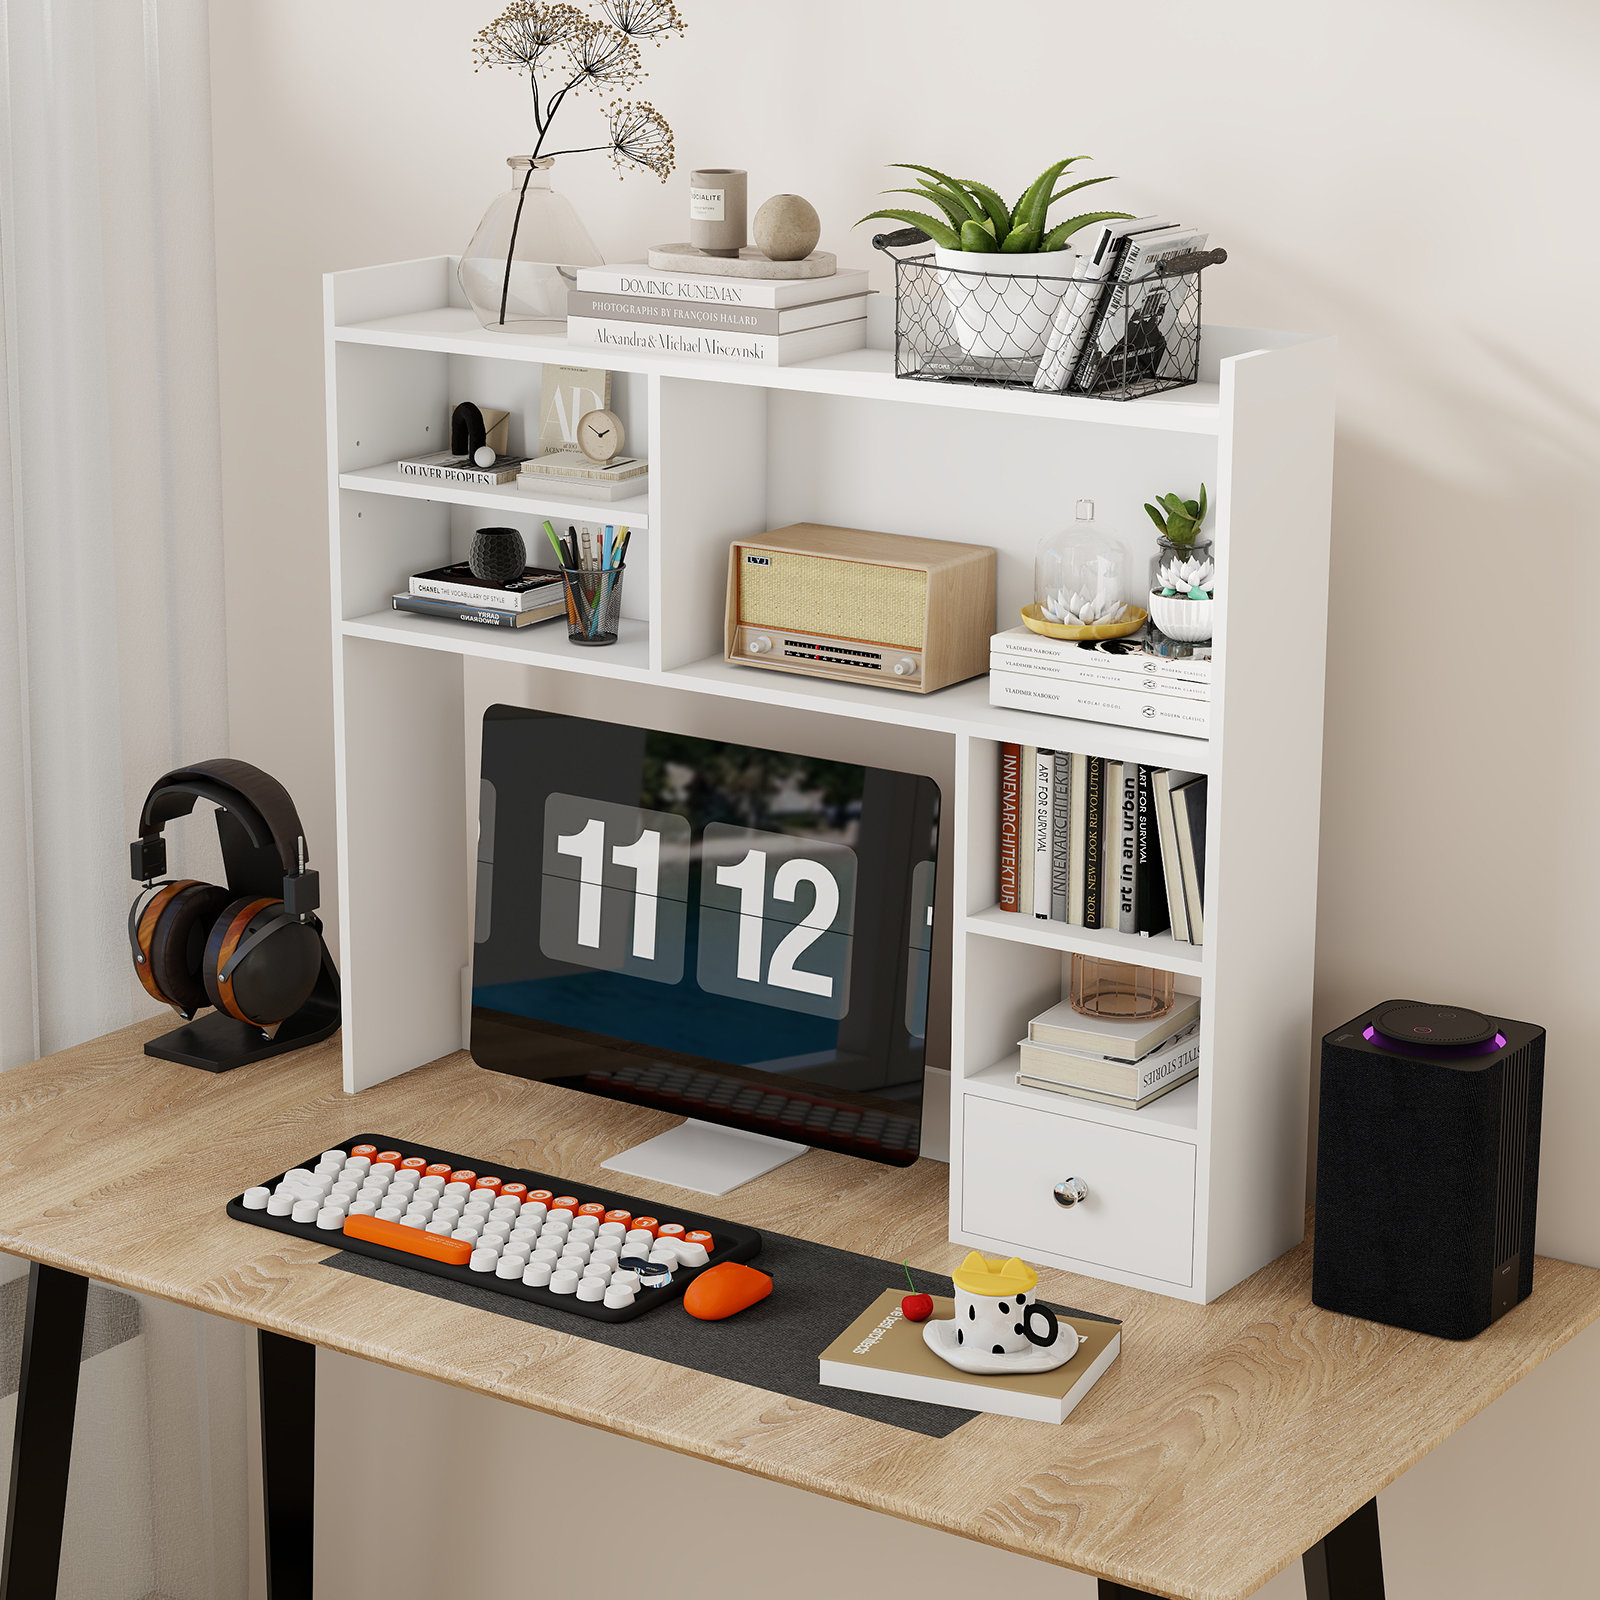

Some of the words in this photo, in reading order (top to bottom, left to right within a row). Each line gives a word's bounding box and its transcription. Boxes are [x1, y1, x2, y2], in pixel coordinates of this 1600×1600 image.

[1125, 244, 1141, 265] FINAL
[620, 278, 674, 297] DOMINIC
[678, 283, 742, 302] KUNEMAN
[592, 301, 659, 317] PHOTOGRAPHS
[661, 308, 672, 318] BY
[673, 309, 718, 323] FRANÇOIS
[720, 313, 758, 326] HALARD
[594, 328, 648, 349] Alexandra
[658, 333, 701, 353] Michael
[704, 338, 764, 360] Misczynski
[539, 384, 604, 443] AD
[418, 584, 441, 594] CHANEL
[440, 587, 450, 596] THE
[450, 588, 483, 601] VOCABULARY
[483, 594, 490, 602] OF
[490, 595, 505, 604] STYLE
[1005, 644, 1034, 654] VLADIMIR
[1034, 648, 1061, 657] NABOKOV
[1005, 660, 1034, 670] VLADIMIR
[1033, 664, 1061, 673] NABOKOV
[1004, 687, 1033, 698] VLADIMIR
[1032, 691, 1060, 701] NABOKOV
[1159, 711, 1182, 719] MODERN
[1182, 714, 1206, 723] CLASSICS
[1039, 763, 1049, 783] ART
[1139, 766, 1147, 788] ART
[1038, 786, 1049, 806] FOR
[1122, 777, 1135, 832] urban
[1139, 791, 1147, 813] FOR
[1001, 754, 1017, 905] INNENARCHITEKTUR
[1037, 809, 1048, 853] SURVIVAL
[1139, 816, 1147, 864] SURVIVAL
[1088, 830, 1098, 862] LOOK
[1123, 837, 1134, 859] an
[1087, 864, 1097, 891] NEW
[1120, 863, 1133, 882] in
[556, 818, 662, 961] 11
[715, 849, 841, 999] 12
[1087, 892, 1096, 924] DIOR.
[1120, 885, 1133, 913] art
[1143, 1058, 1177, 1088] STORIES
